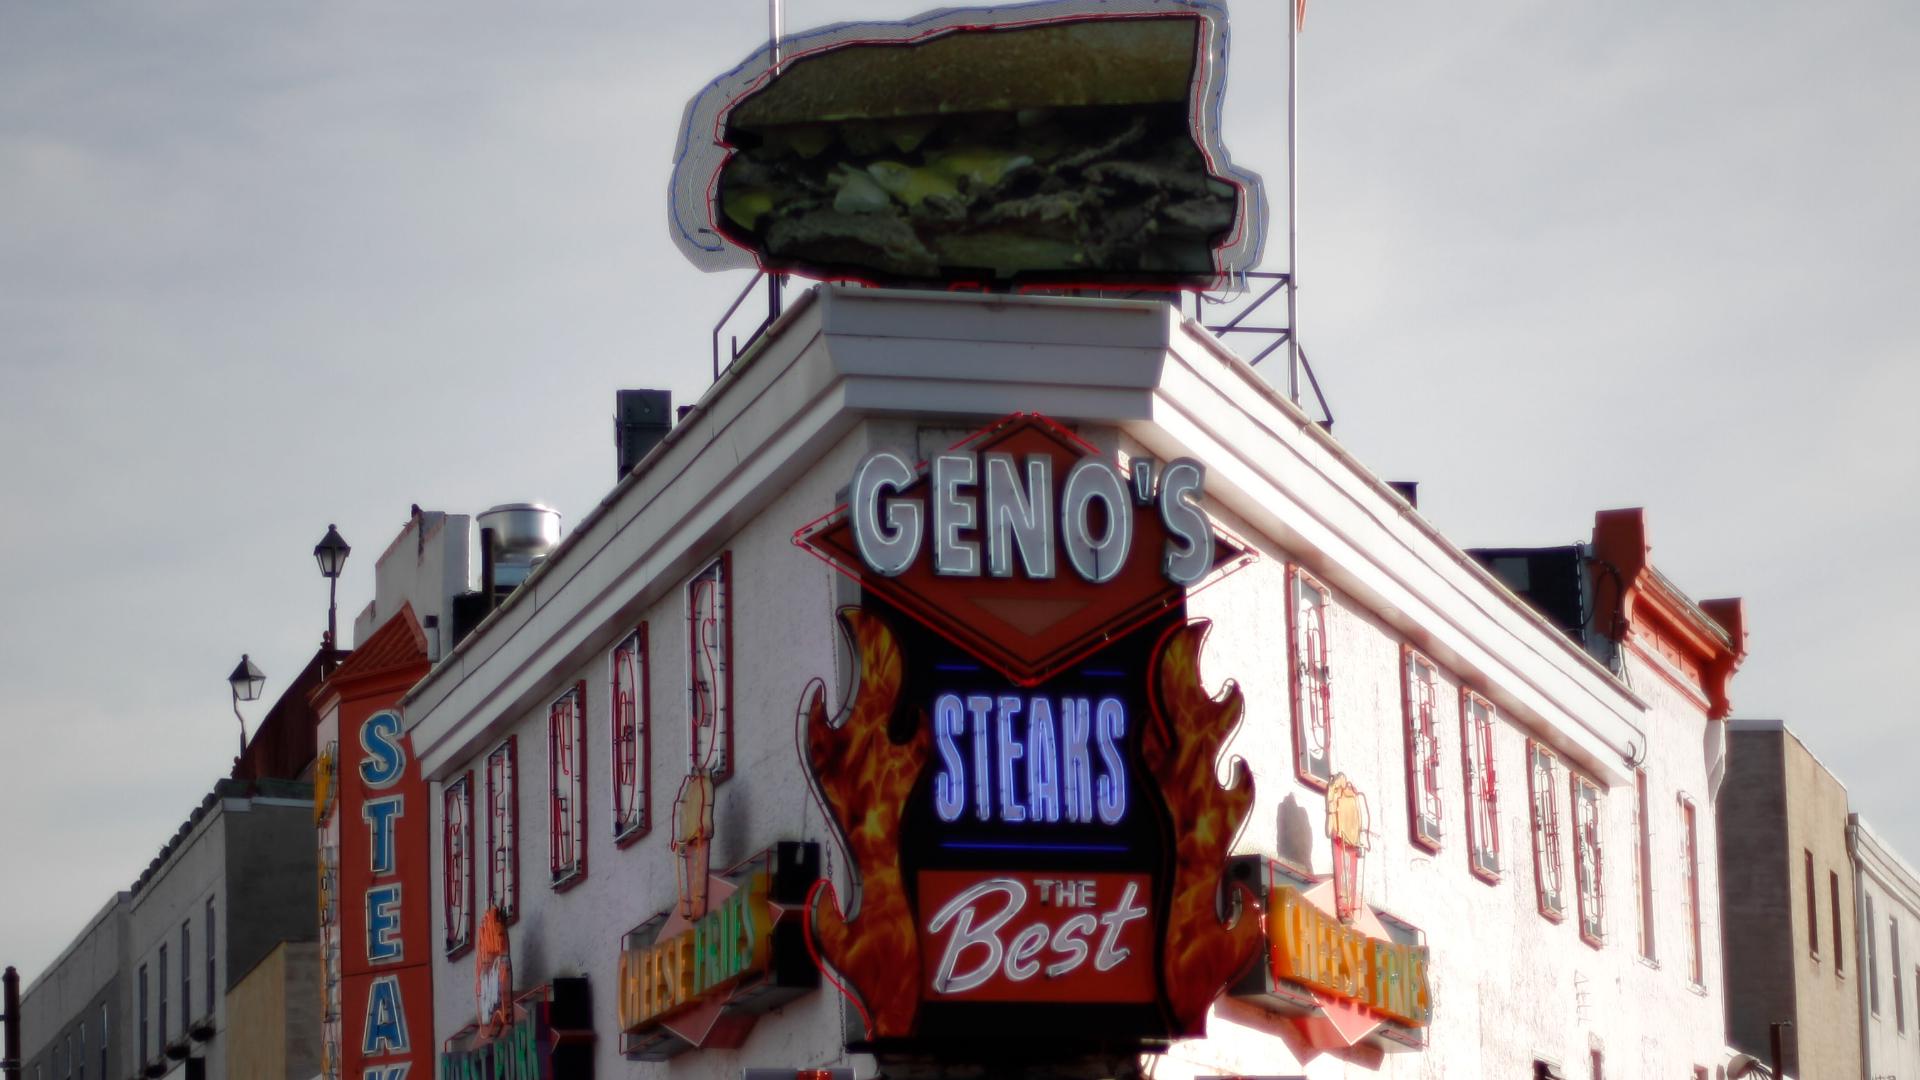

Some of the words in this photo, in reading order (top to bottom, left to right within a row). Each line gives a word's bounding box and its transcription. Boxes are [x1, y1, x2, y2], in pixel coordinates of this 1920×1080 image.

[849, 451, 1215, 586] GENO'S
[933, 693, 1128, 826] STEAKS
[359, 709, 412, 1080] STEA
[619, 931, 693, 1030] CHEESE
[694, 886, 755, 996] FRIES
[927, 876, 1149, 994] Best
[1034, 878, 1097, 908] THE
[1284, 896, 1368, 1002] CHEESE
[1374, 942, 1433, 1026] FRIES
